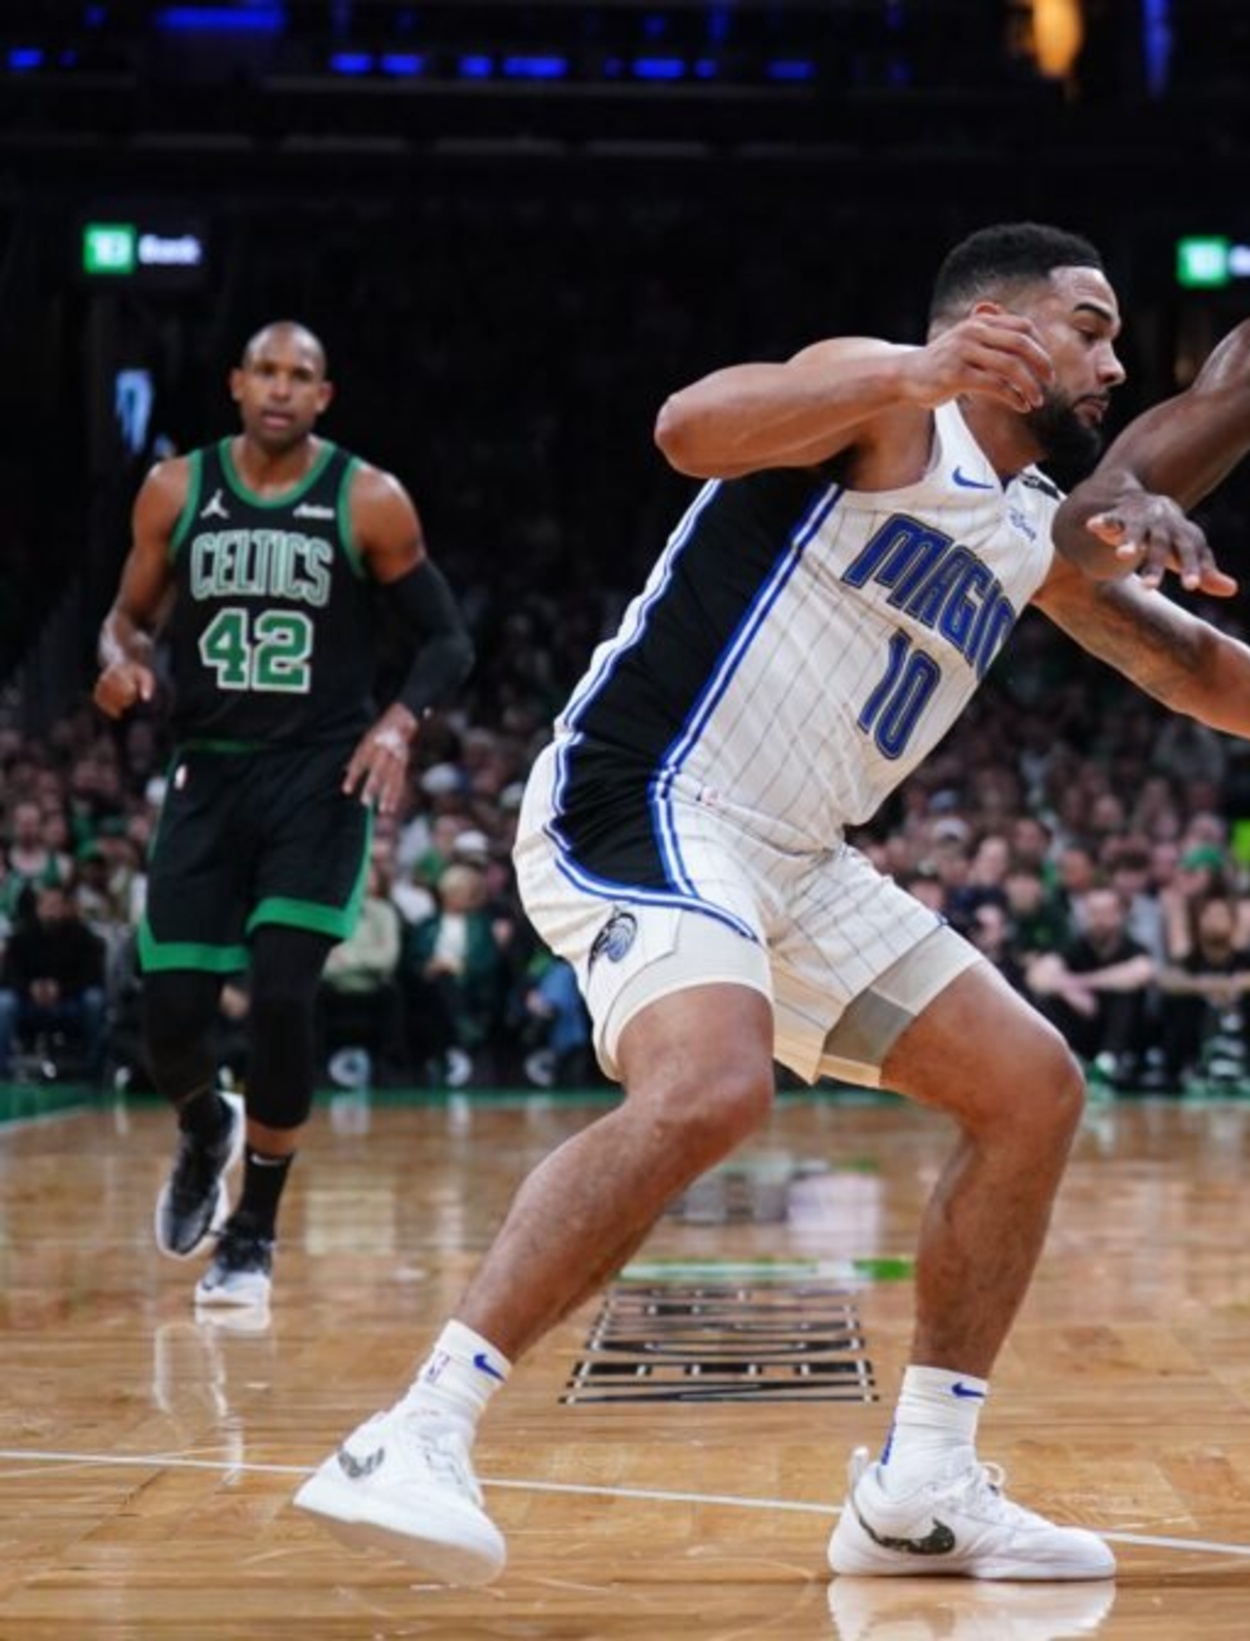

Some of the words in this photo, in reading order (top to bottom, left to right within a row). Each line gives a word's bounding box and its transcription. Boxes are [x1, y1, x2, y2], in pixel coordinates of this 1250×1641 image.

[190, 528, 334, 607] CELTICS
[198, 608, 314, 693] 42
[857, 627, 941, 760] 10
